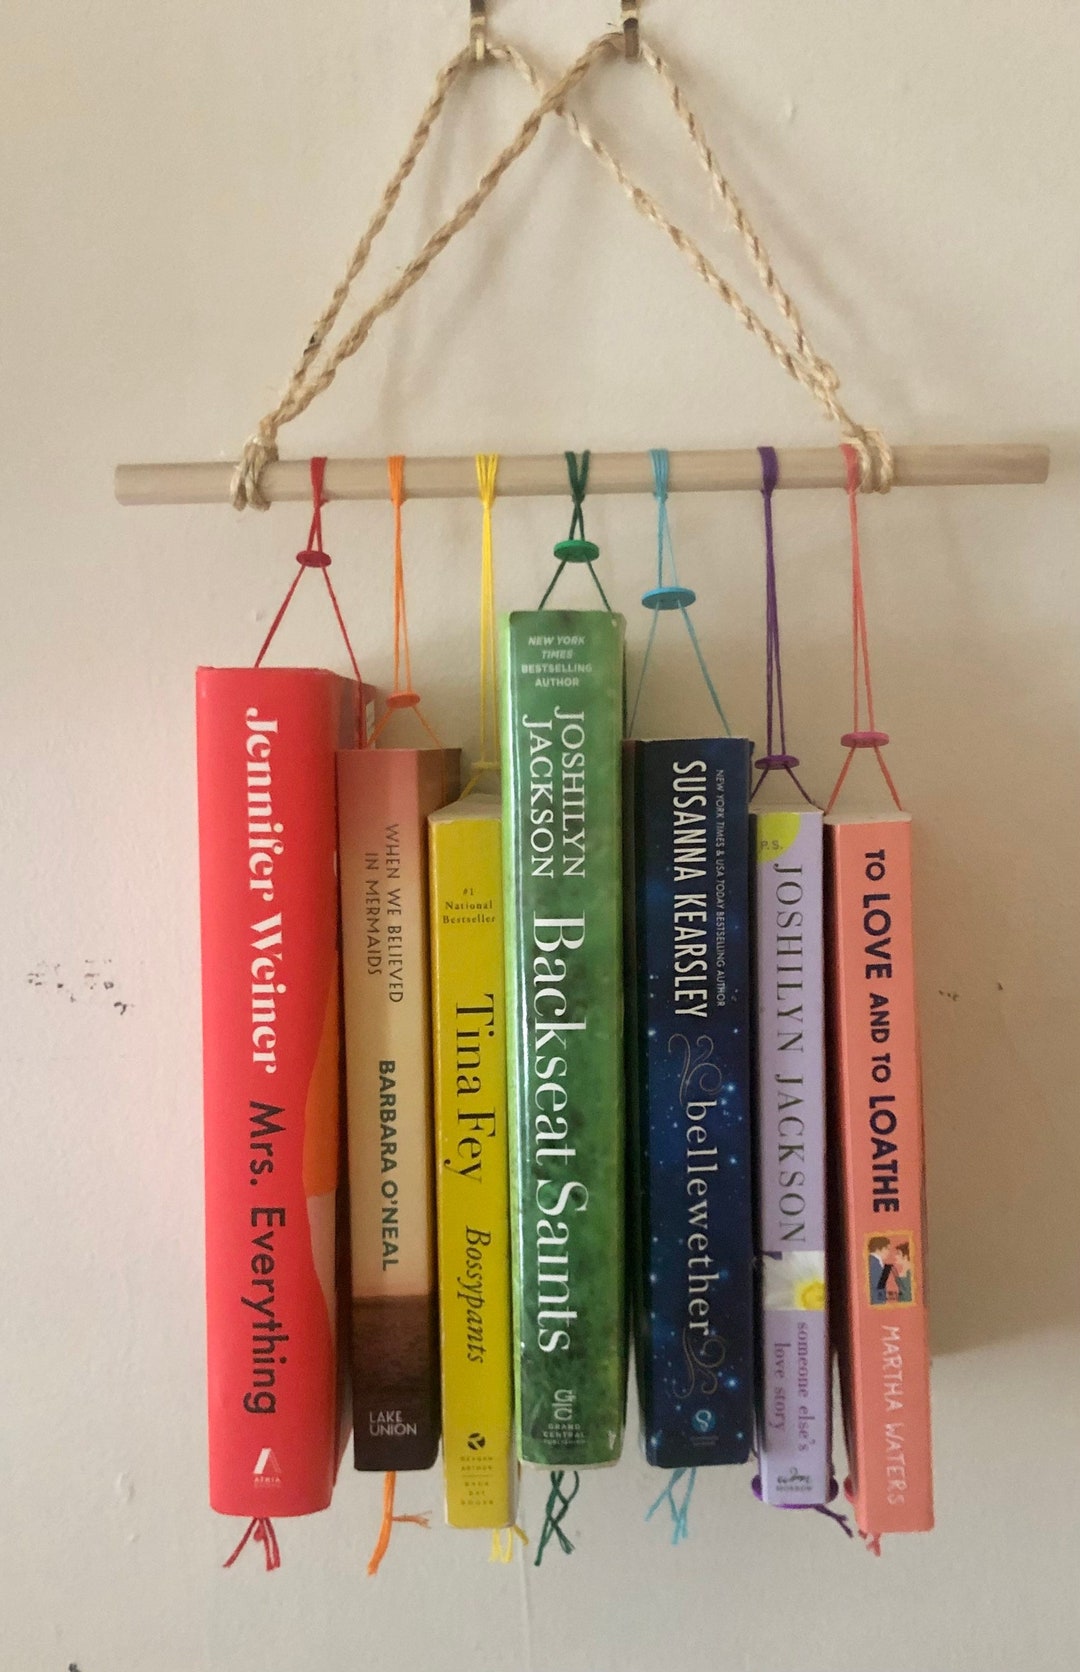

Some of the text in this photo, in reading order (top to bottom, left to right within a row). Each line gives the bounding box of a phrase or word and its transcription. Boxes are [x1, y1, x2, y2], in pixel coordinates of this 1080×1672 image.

[521, 663, 593, 674] BESTSELLING
[528, 635, 586, 646] NEW YORK
[541, 649, 574, 659] TIMES
[534, 677, 580, 687] AUTHOR
[522, 714, 554, 880] JACKSON
[554, 706, 586, 879] JOSHILYN
[716, 769, 724, 791] NEW
[716, 794, 725, 818] YORK
[716, 821, 725, 847] TIMES
[716, 859, 725, 877] USA
[760, 839, 784, 851] P.S.
[245, 706, 287, 1075] Jennifer Weiner
[365, 852, 382, 976] IN MERMAIDS
[385, 823, 404, 1004] WHEN WE BELIEVED
[443, 914, 496, 924] Bestseller
[445, 899, 493, 910] National
[672, 759, 708, 1019] SUSANNA KEARSLEY
[716, 879, 725, 908] TODAY
[716, 911, 726, 967] BESTSELLING
[716, 970, 726, 1007] AUTHOR
[774, 863, 806, 1242] JOSHILYN JACKSON
[862, 848, 900, 1213] TO LOVE AND TO LOATHE
[443, 992, 498, 1183] Tina Fey
[378, 1059, 399, 1271] BARBARA O'NEAL
[532, 910, 590, 1353] Backseat Saints
[685, 1100, 720, 1336] bellewether
[240, 1100, 290, 1415] Mrs. Everything
[456, 1225, 492, 1365] Bossypants
[767, 1341, 792, 1433] love story
[798, 1321, 809, 1398] someone
[369, 1410, 403, 1423] LAKE
[369, 1423, 418, 1436] UNION
[881, 1324, 908, 1506] MARTHA WATERS
